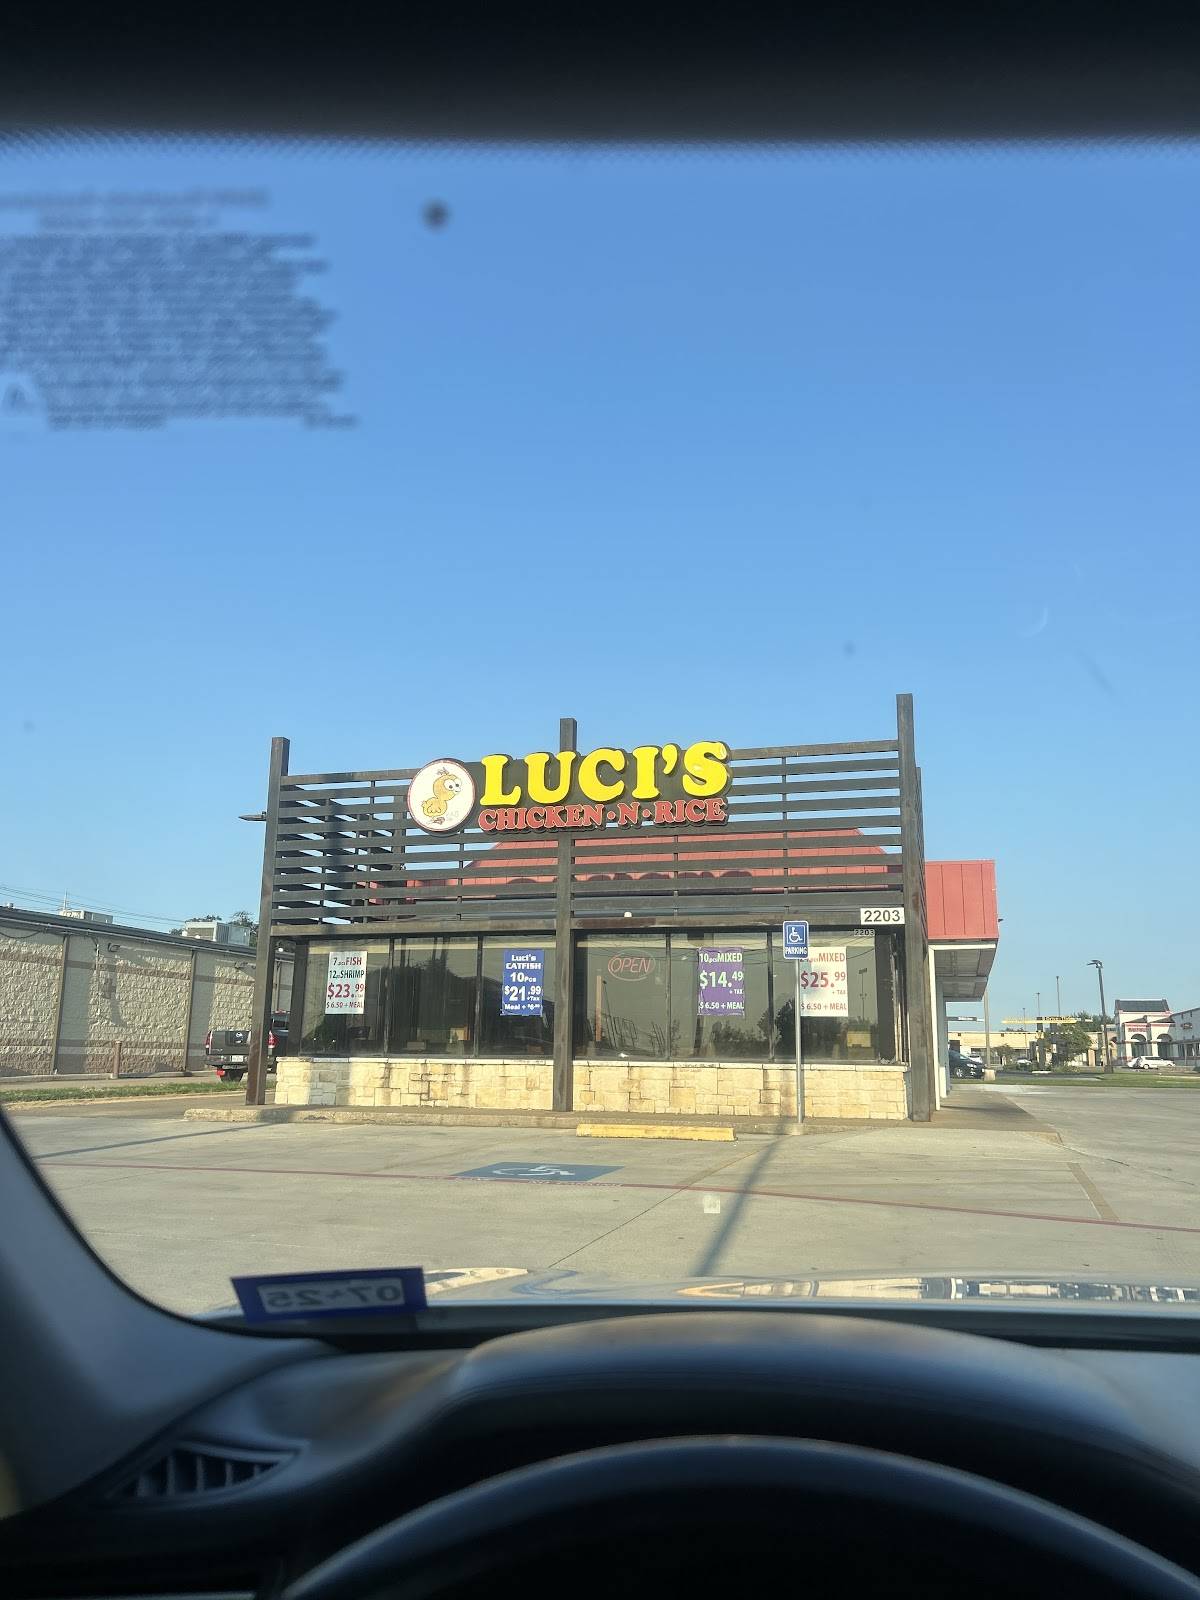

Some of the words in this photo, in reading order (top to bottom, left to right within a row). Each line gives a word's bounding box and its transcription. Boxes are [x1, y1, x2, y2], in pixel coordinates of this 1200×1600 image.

[479, 741, 730, 806] LUCI'S
[478, 804, 604, 832] CHICKEN
[654, 798, 726, 823] RICE
[864, 910, 900, 922] 2203
[718, 953, 742, 962] MIXED
[785, 946, 808, 954] PARKING
[819, 953, 845, 962] MIXED
[346, 957, 362, 965] FISH
[610, 958, 650, 973] OPEN
[700, 970, 743, 989] $14.49
[801, 971, 846, 989] $25.99
[328, 983, 364, 999] $23.99
[504, 985, 541, 1001] $21.99
